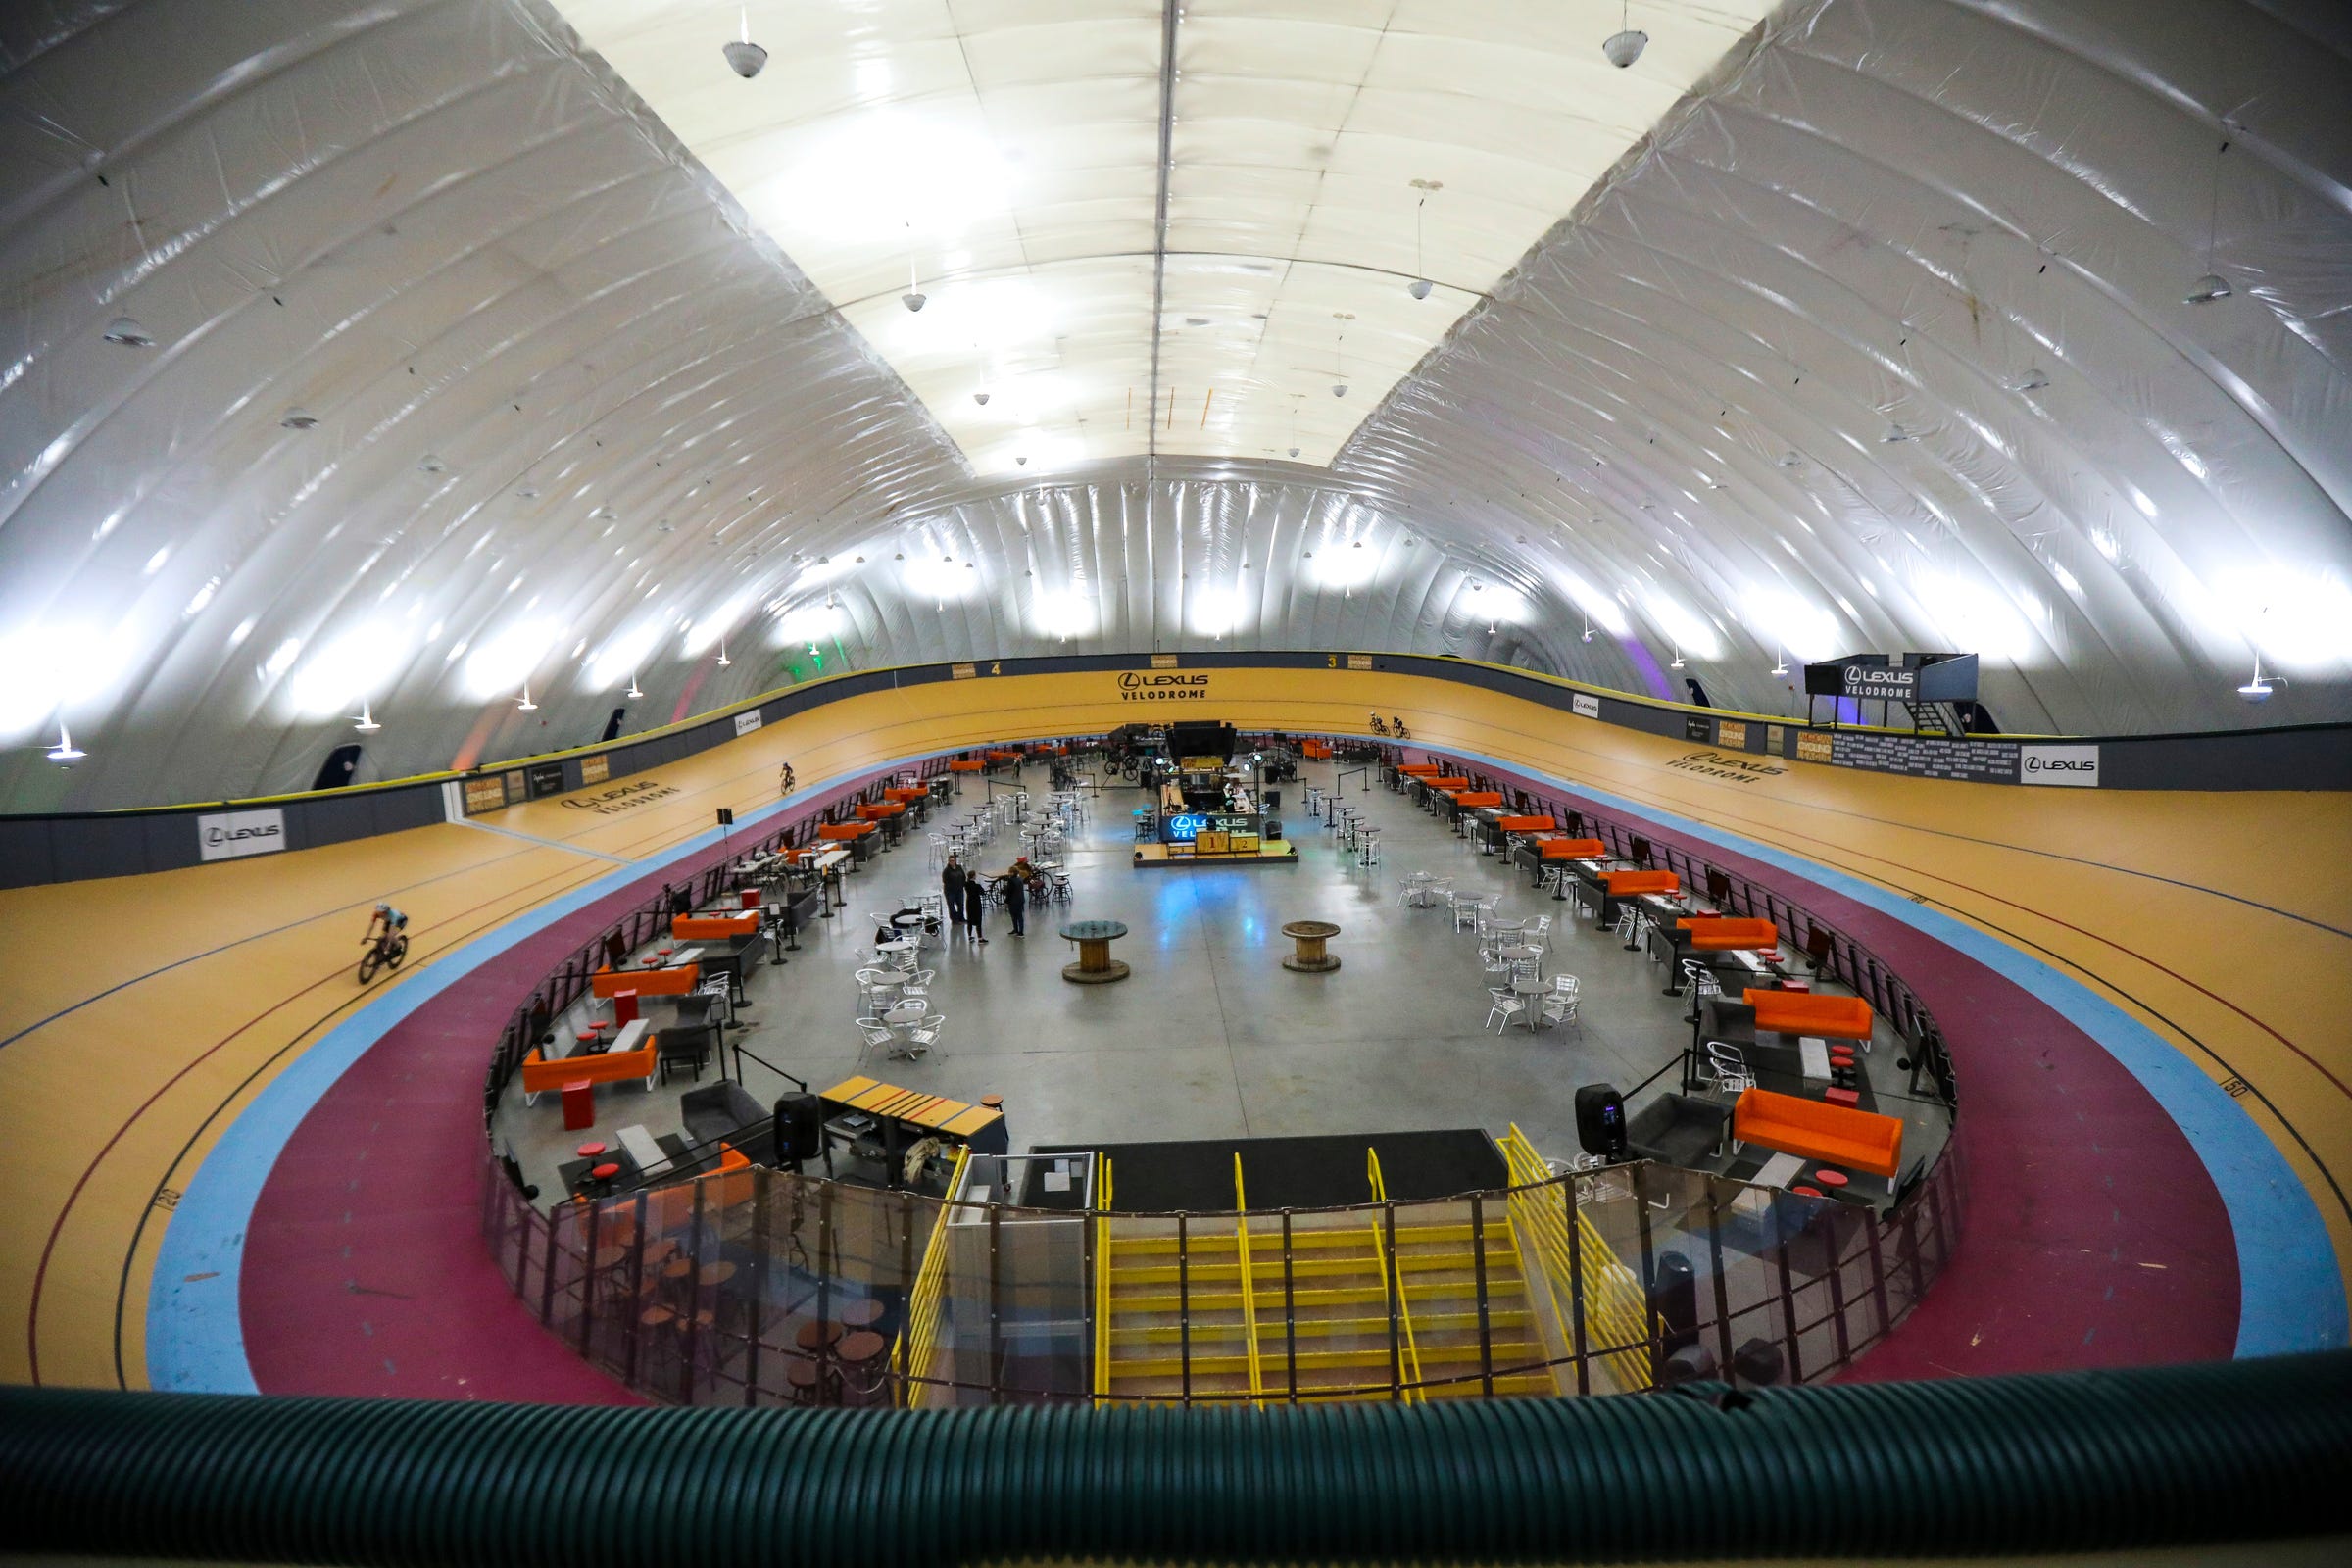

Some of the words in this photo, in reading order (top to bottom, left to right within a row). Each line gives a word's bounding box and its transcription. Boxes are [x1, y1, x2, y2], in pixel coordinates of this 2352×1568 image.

[990, 662, 1001, 675] 4
[1328, 656, 1337, 668] 3
[1142, 674, 1208, 686] LEXUS
[1863, 670, 1914, 684] LEXUS
[1121, 689, 1206, 701] VELODROME
[1845, 685, 1912, 699] VELODROME
[1665, 760, 1761, 783] VELODROME
[1708, 756, 1788, 775] LEXUS
[2042, 760, 2095, 771] LEXUS
[589, 781, 658, 803] LEXUS
[593, 787, 681, 814] VELODROME
[224, 825, 280, 841] LEXUS
[1209, 837, 1216, 848] 1
